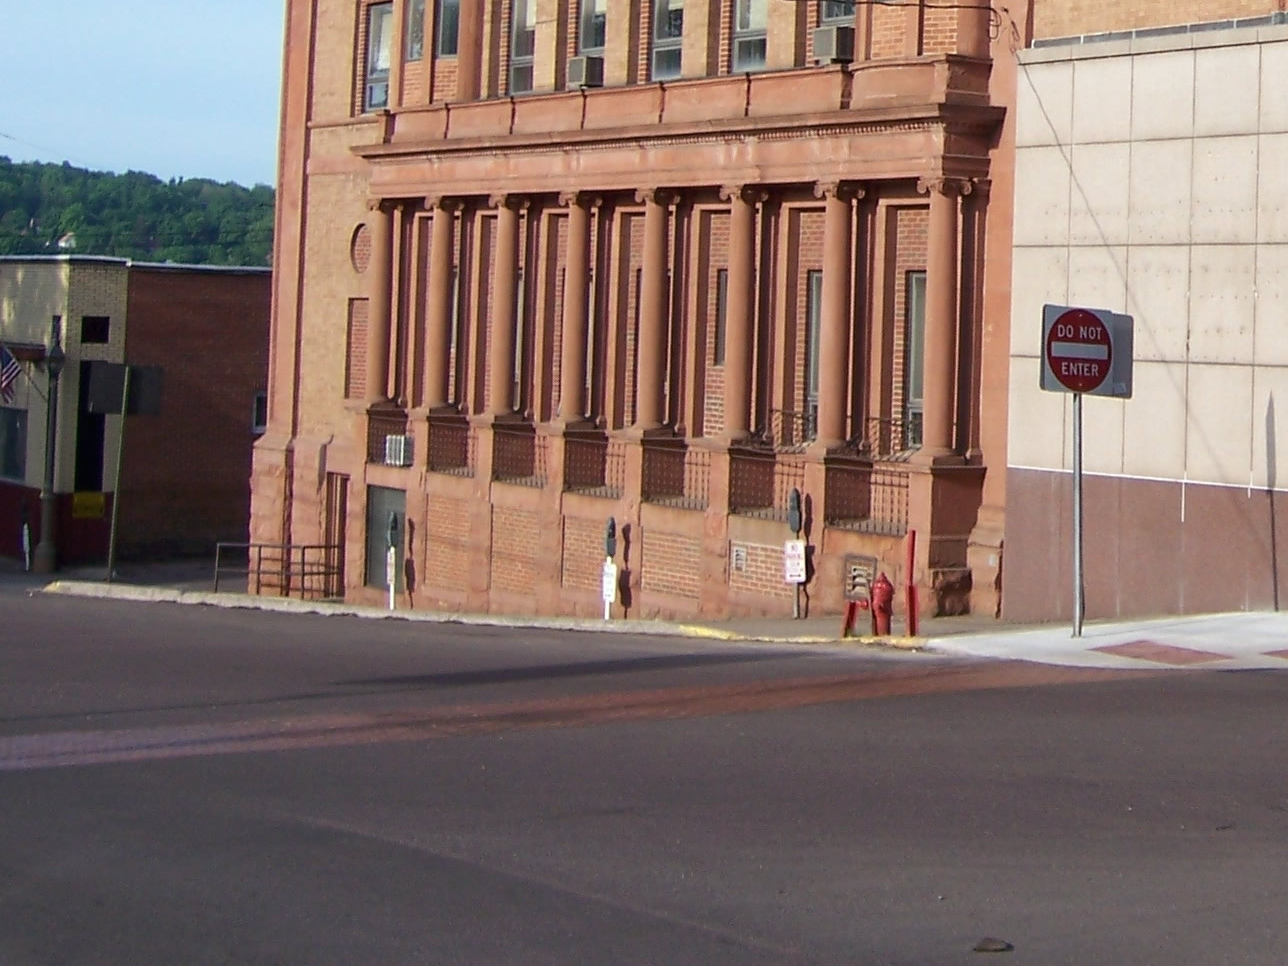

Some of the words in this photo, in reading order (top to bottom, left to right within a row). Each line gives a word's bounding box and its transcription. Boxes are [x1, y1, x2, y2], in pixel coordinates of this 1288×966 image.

[1058, 325, 1074, 338] DO
[1080, 326, 1102, 340] NOT
[1062, 362, 1099, 376] ENTER
